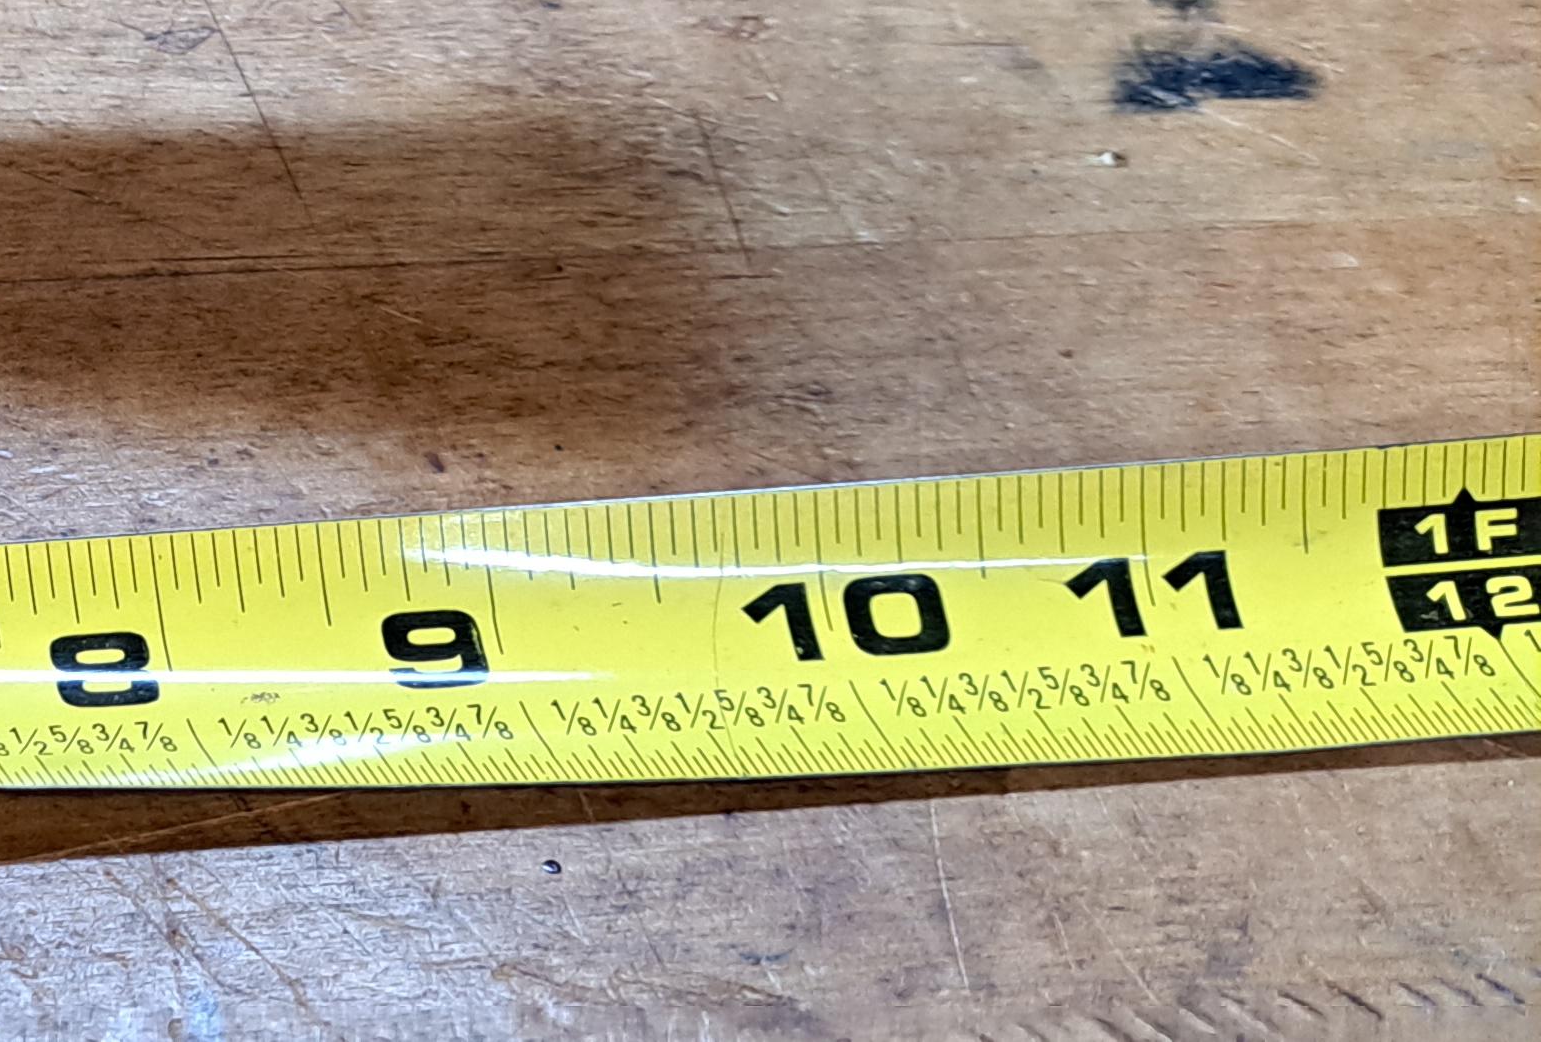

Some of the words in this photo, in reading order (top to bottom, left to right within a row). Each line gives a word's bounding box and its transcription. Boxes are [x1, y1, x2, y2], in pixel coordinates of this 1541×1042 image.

[9, 726, 54, 757] 1/2
[48, 724, 95, 755] 5/8
[91, 723, 136, 754] 3/4
[133, 721, 177, 753] 7/8
[217, 717, 262, 750] 1/8
[260, 715, 303, 748] 1/4
[299, 713, 348, 747] 3/8
[343, 710, 392, 746] 1/2
[383, 708, 432, 744] 5/8
[425, 706, 472, 742] 3/4
[467, 703, 514, 741] 7/8
[550, 699, 598, 737] 1/8
[592, 696, 638, 734] 1/4
[631, 694, 682, 732] 3/8
[674, 691, 725, 730] 1/2
[714, 689, 766, 729] 5/8
[756, 686, 805, 725] 3/4
[797, 683, 847, 723] 7/8
[880, 678, 927, 718] 1/8
[920, 675, 966, 714] 1/4
[958, 672, 1009, 713] 3/8
[1001, 669, 1051, 710] 1/2
[1037, 666, 1090, 707] 5/8
[1080, 663, 1130, 704] 3/4
[1120, 660, 1171, 702] 7/8
[1202, 654, 1252, 697] 1/8
[1244, 651, 1292, 693] 1/4
[1281, 648, 1335, 690] 3/8
[1324, 645, 1376, 687] 1/2
[1361, 641, 1416, 684] 5/8
[1403, 638, 1455, 680] 3/4
[1443, 635, 1497, 677] 7/8
[49, 631, 160, 708] 8
[381, 609, 491, 689] 9
[741, 572, 951, 662] 10
[1063, 550, 1244, 638] 11
[1426, 575, 1540, 622] 12
